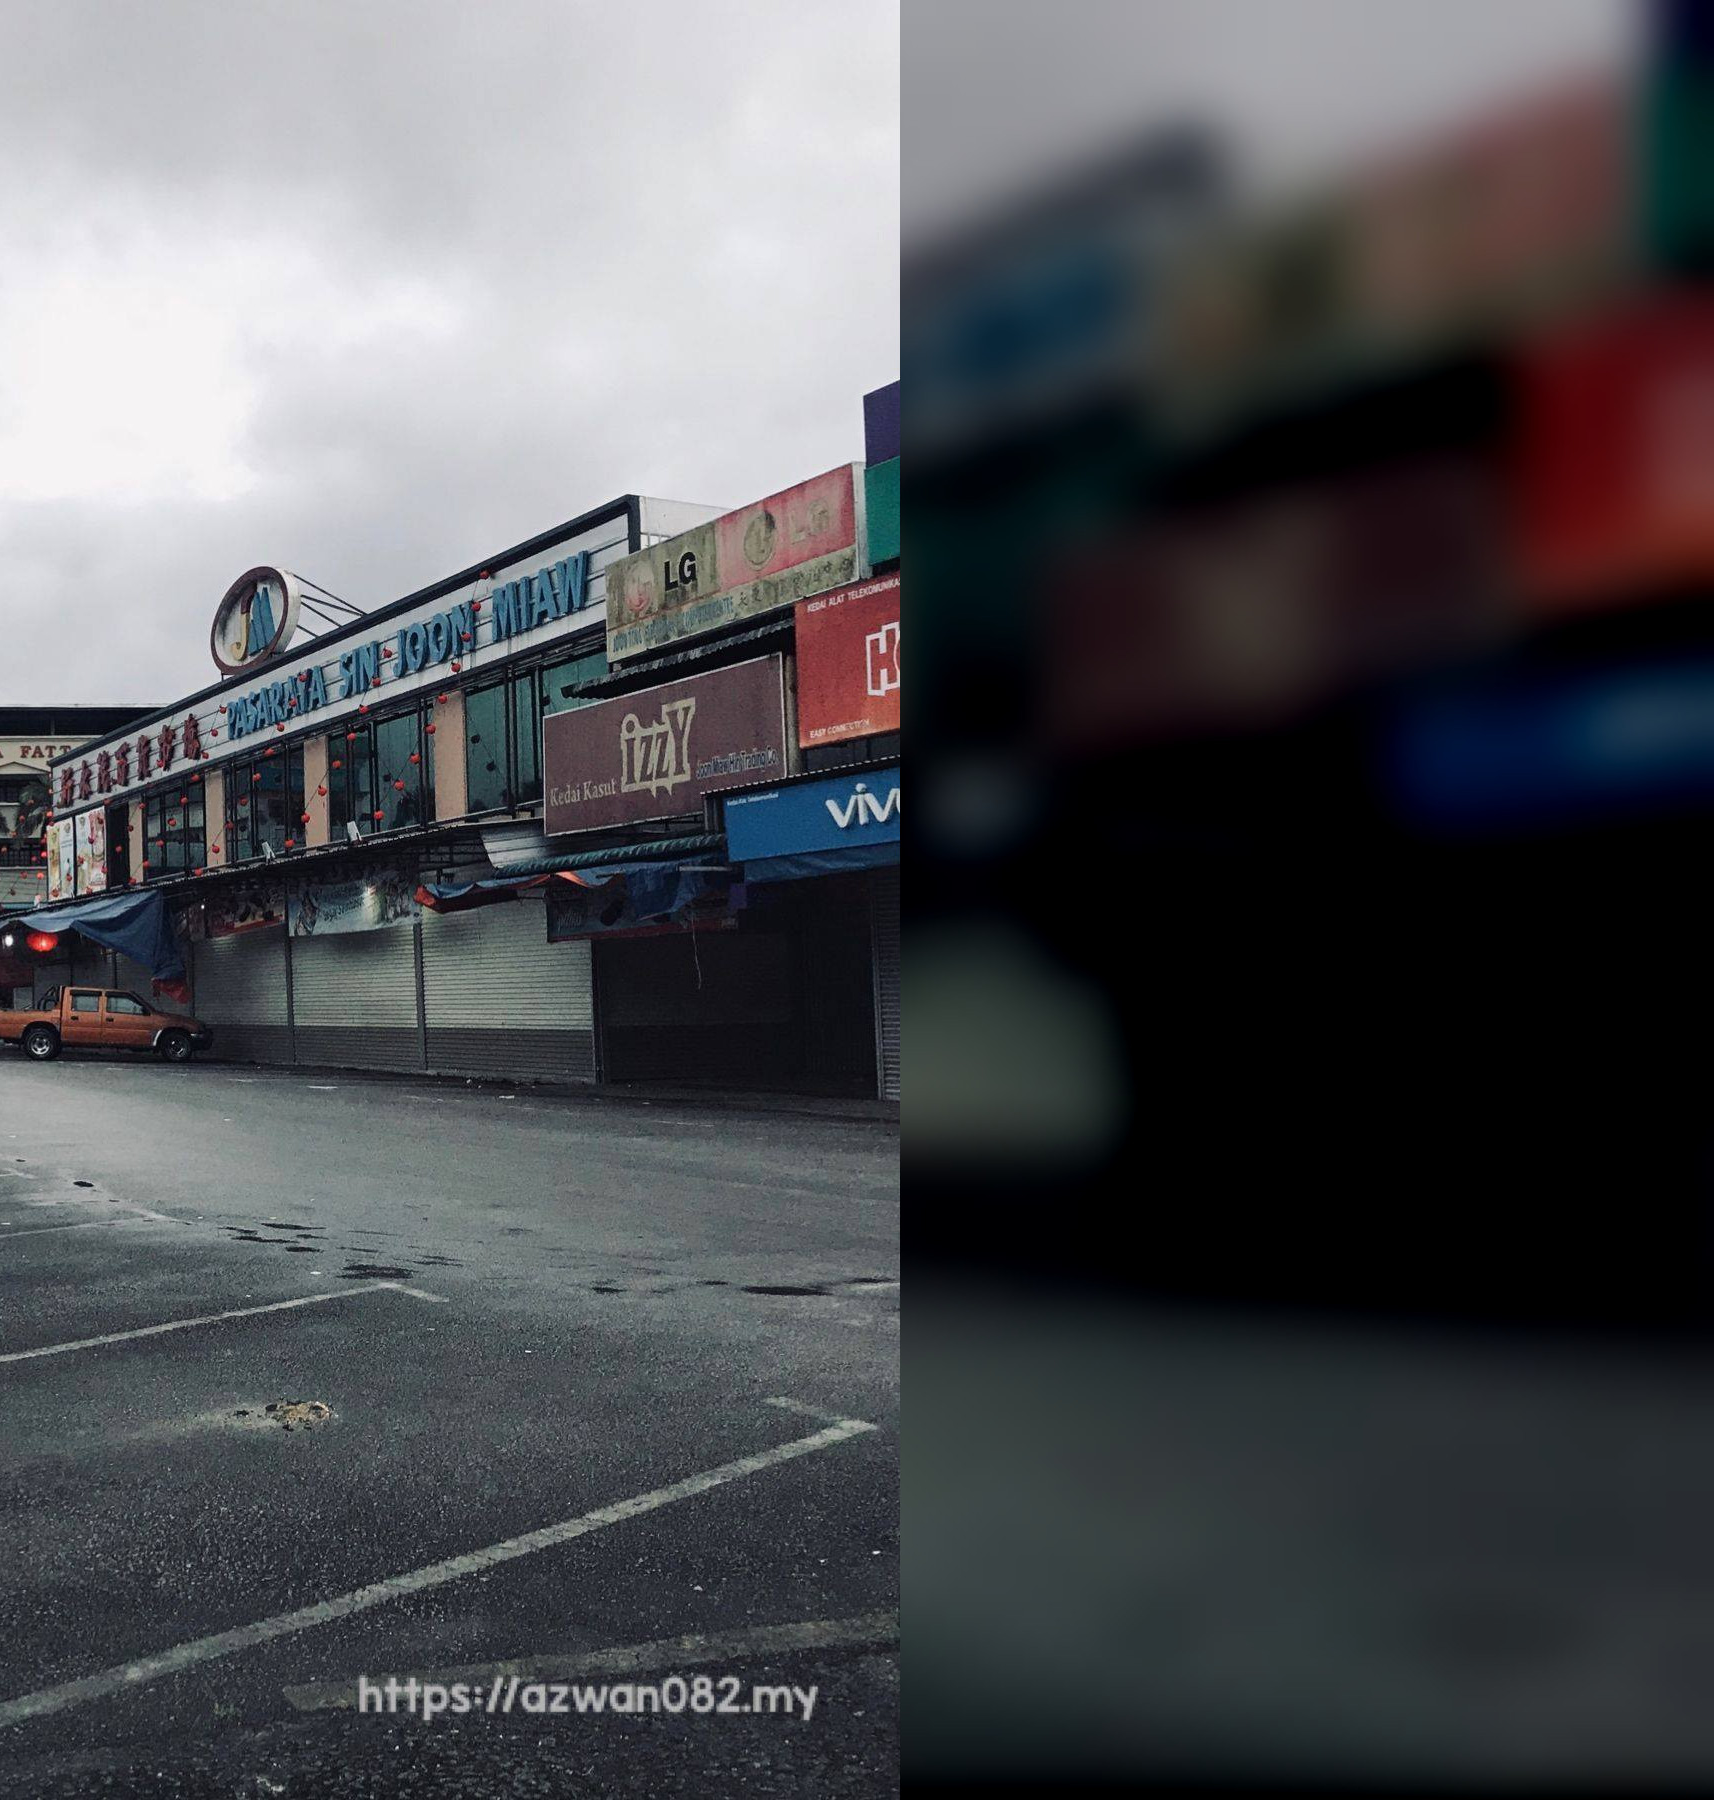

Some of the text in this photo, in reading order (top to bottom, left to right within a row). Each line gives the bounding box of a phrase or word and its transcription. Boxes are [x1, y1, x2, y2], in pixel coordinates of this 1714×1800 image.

[664, 551, 697, 592] LG
[807, 601, 826, 613] KEDAI
[828, 594, 845, 606] ALAT
[227, 665, 327, 740] PASARAYA
[339, 640, 379, 698] SIN
[393, 600, 476, 678] JOON
[492, 551, 588, 641] MIAW
[809, 728, 826, 738] EASY
[742, 748, 766, 771] Trading
[550, 779, 616, 807] Kedai Kasut
[825, 783, 900, 828] viv
